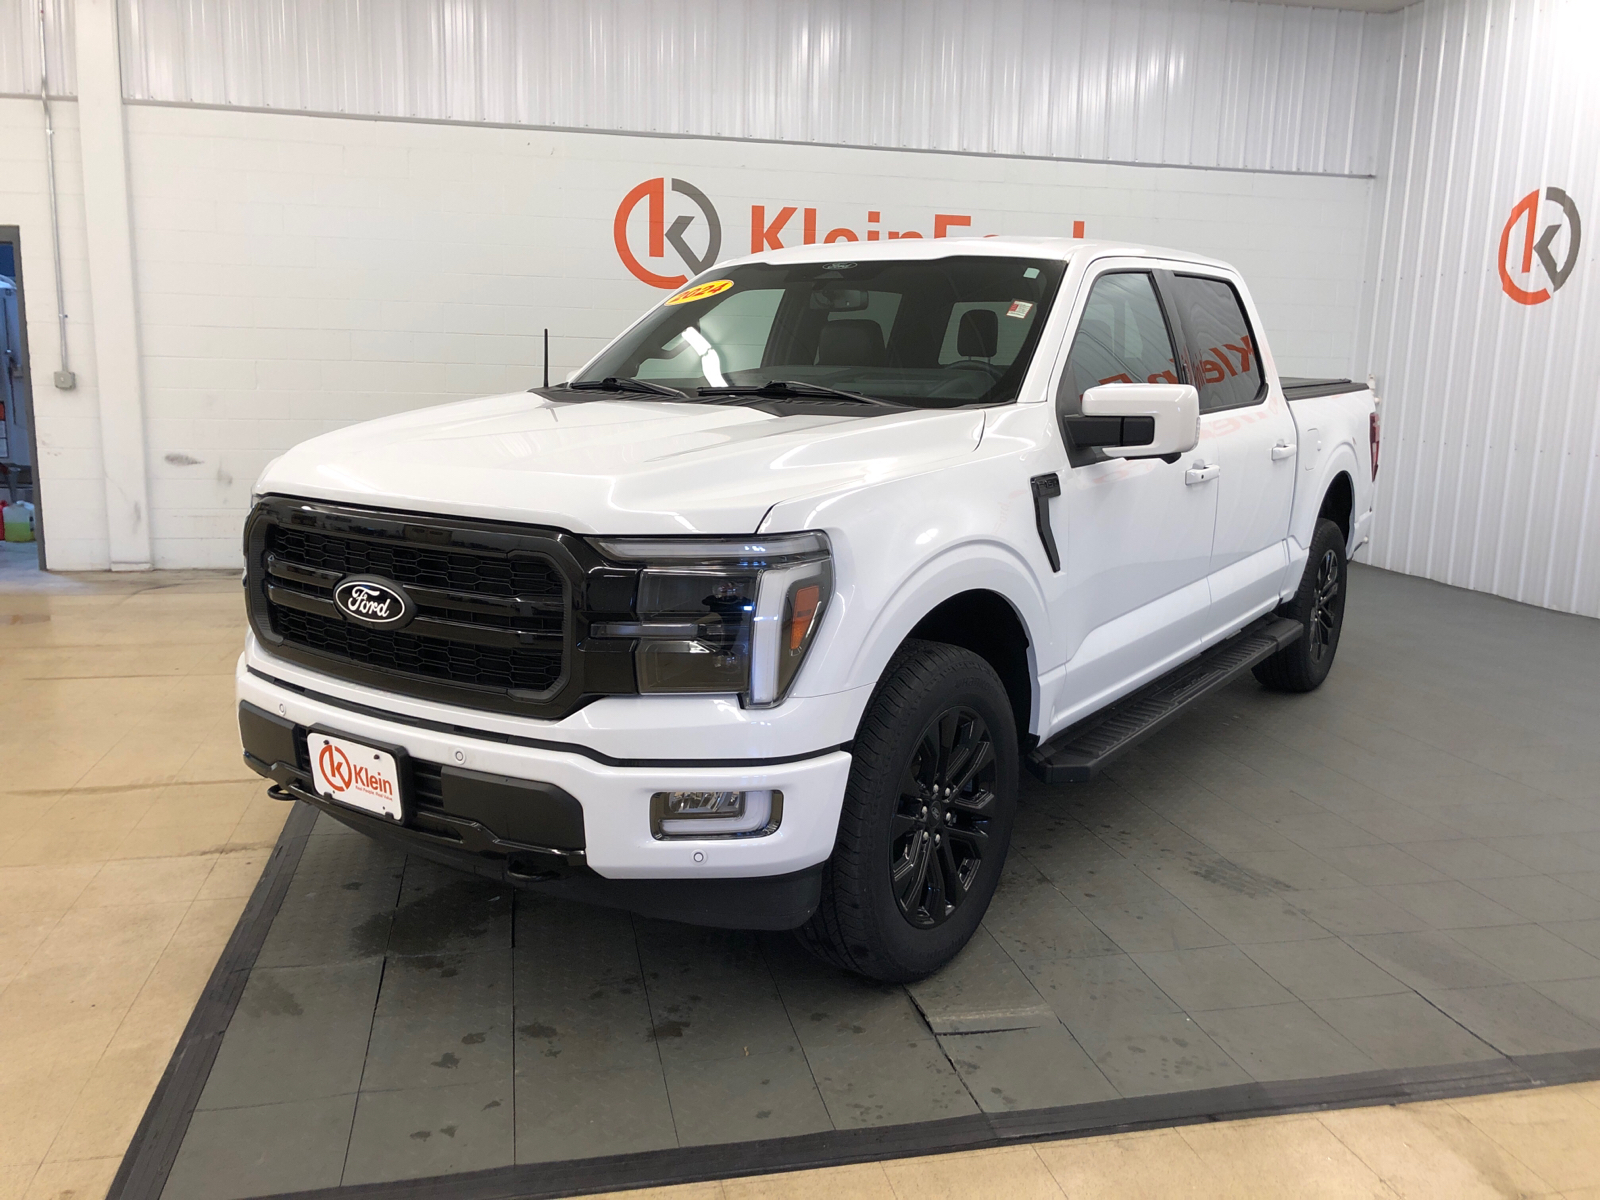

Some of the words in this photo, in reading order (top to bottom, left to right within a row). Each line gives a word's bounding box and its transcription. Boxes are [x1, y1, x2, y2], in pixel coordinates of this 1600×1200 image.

[667, 282, 730, 304] 2024
[347, 586, 391, 618] Ford
[353, 764, 393, 796] Klein
